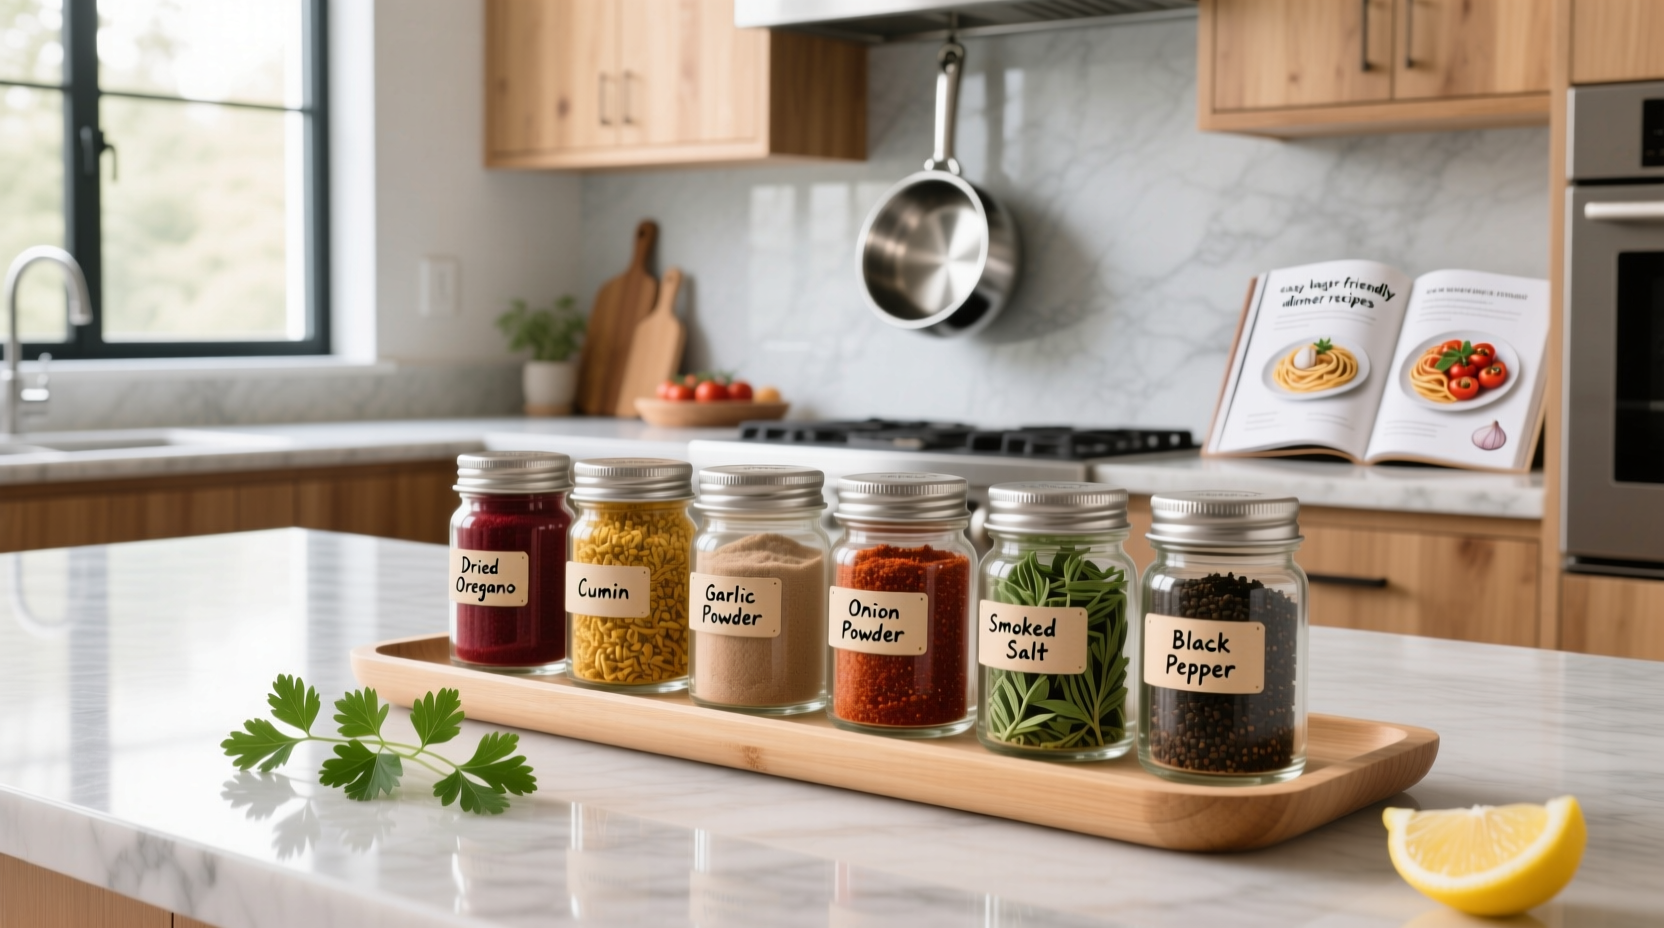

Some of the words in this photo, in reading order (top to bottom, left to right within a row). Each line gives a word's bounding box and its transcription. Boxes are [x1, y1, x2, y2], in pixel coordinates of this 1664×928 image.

[1343, 276, 1396, 302] friendly
[461, 555, 500, 575] Dried
[456, 576, 517, 602] Oregano
[578, 577, 630, 600] Cumin
[705, 583, 756, 604] Garlic
[702, 604, 763, 626] Powder
[848, 598, 900, 620] Onion
[841, 620, 906, 643] Powder
[988, 613, 1057, 638] Smoked
[1005, 639, 1049, 662] Salt
[1172, 629, 1231, 654] Black
[1165, 653, 1237, 686] Pepper
